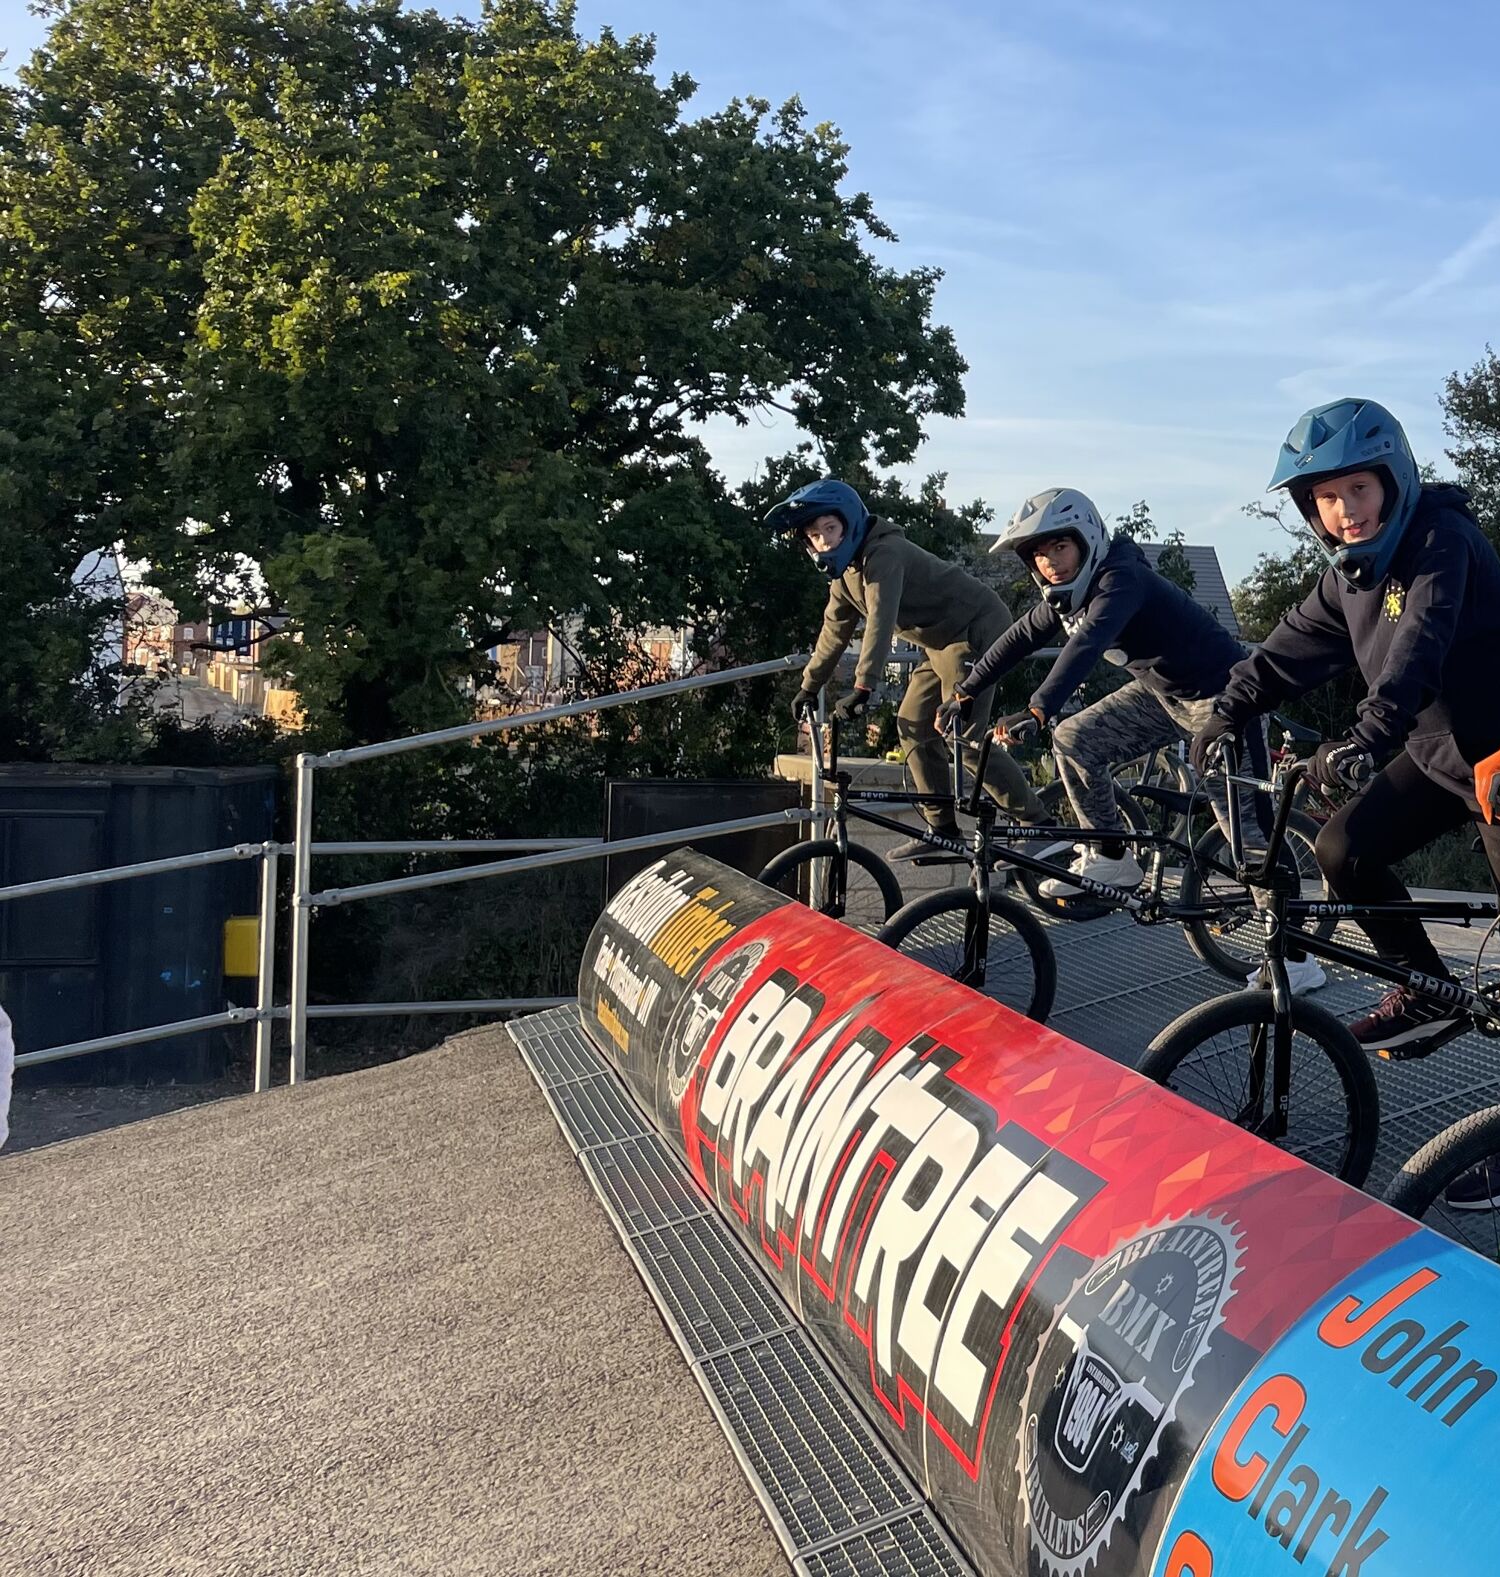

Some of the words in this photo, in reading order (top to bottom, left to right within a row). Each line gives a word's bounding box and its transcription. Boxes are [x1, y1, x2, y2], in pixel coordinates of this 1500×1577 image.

[607, 859, 694, 946] Basildon
[648, 886, 736, 978] Timber
[700, 980, 1079, 1427] BRAINTREE
[1098, 1279, 1176, 1362] BMX
[1119, 1227, 1224, 1325] BRAINTREE
[1317, 1267, 1498, 1429] John
[1062, 1377, 1107, 1455] 1984
[1026, 1461, 1085, 1556] BULLETS
[1210, 1373, 1390, 1577] Clark
